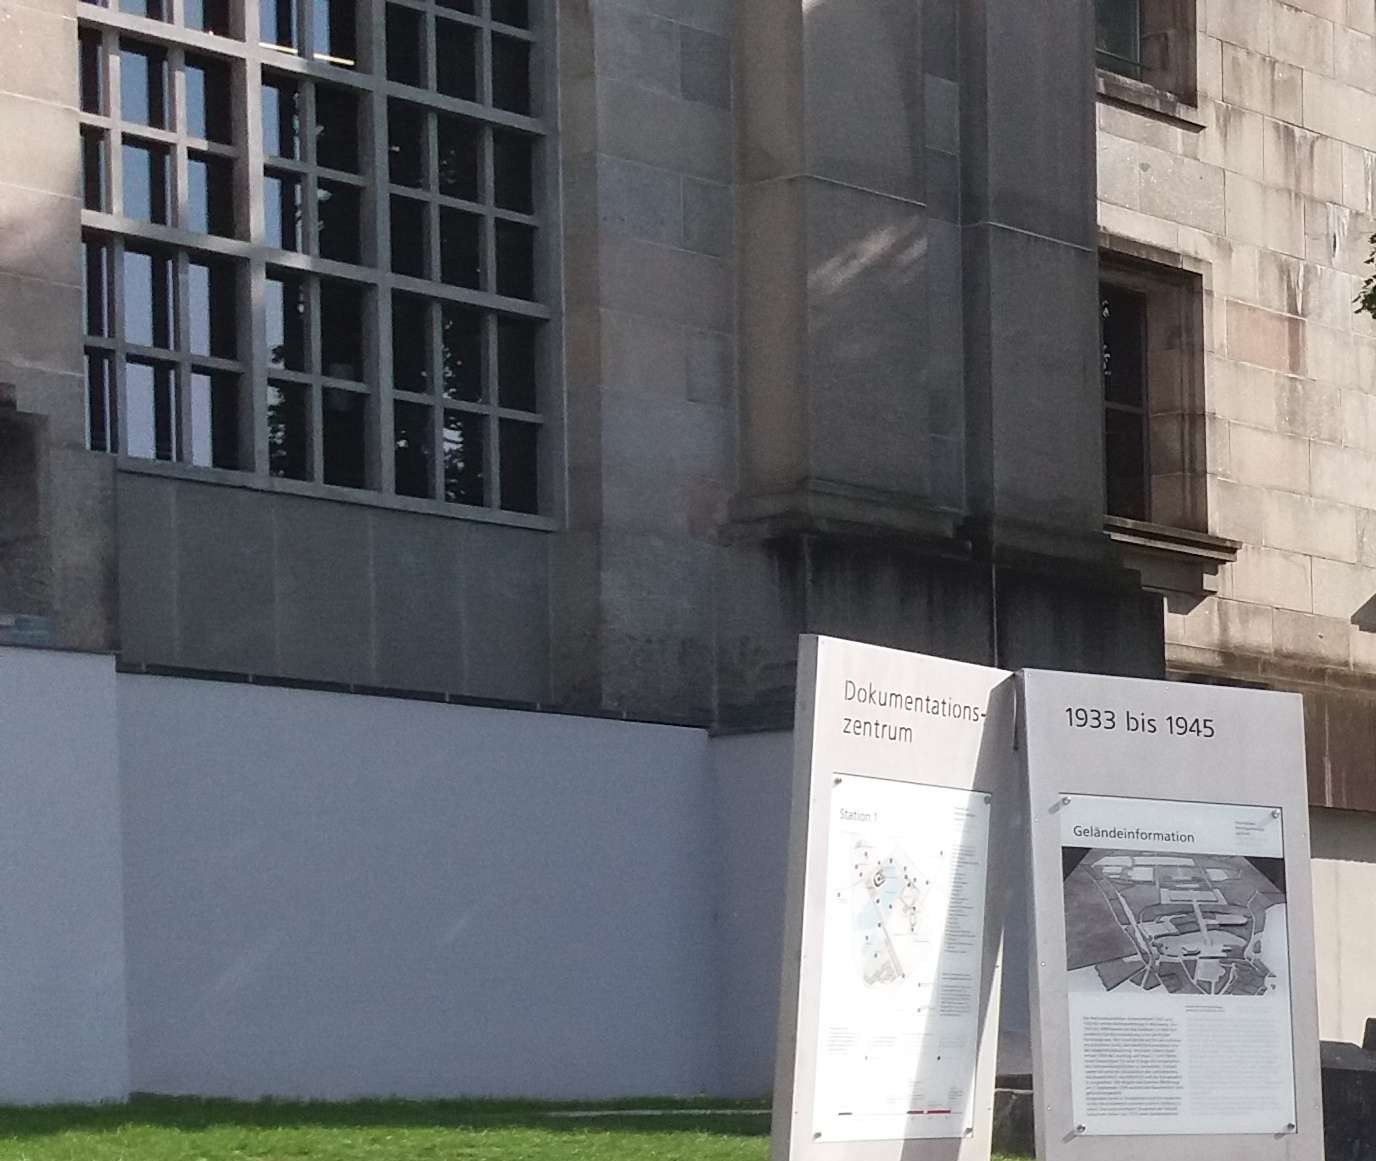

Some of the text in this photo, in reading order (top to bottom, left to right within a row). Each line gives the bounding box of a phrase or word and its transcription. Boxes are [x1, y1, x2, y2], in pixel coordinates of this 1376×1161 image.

[844, 679, 986, 722] Dokumentations-
[843, 717, 913, 743] zentrum
[1065, 707, 1215, 738] 1933 bis 1945
[840, 808, 871, 822] Station
[1073, 825, 1195, 843] Geländeinformation
